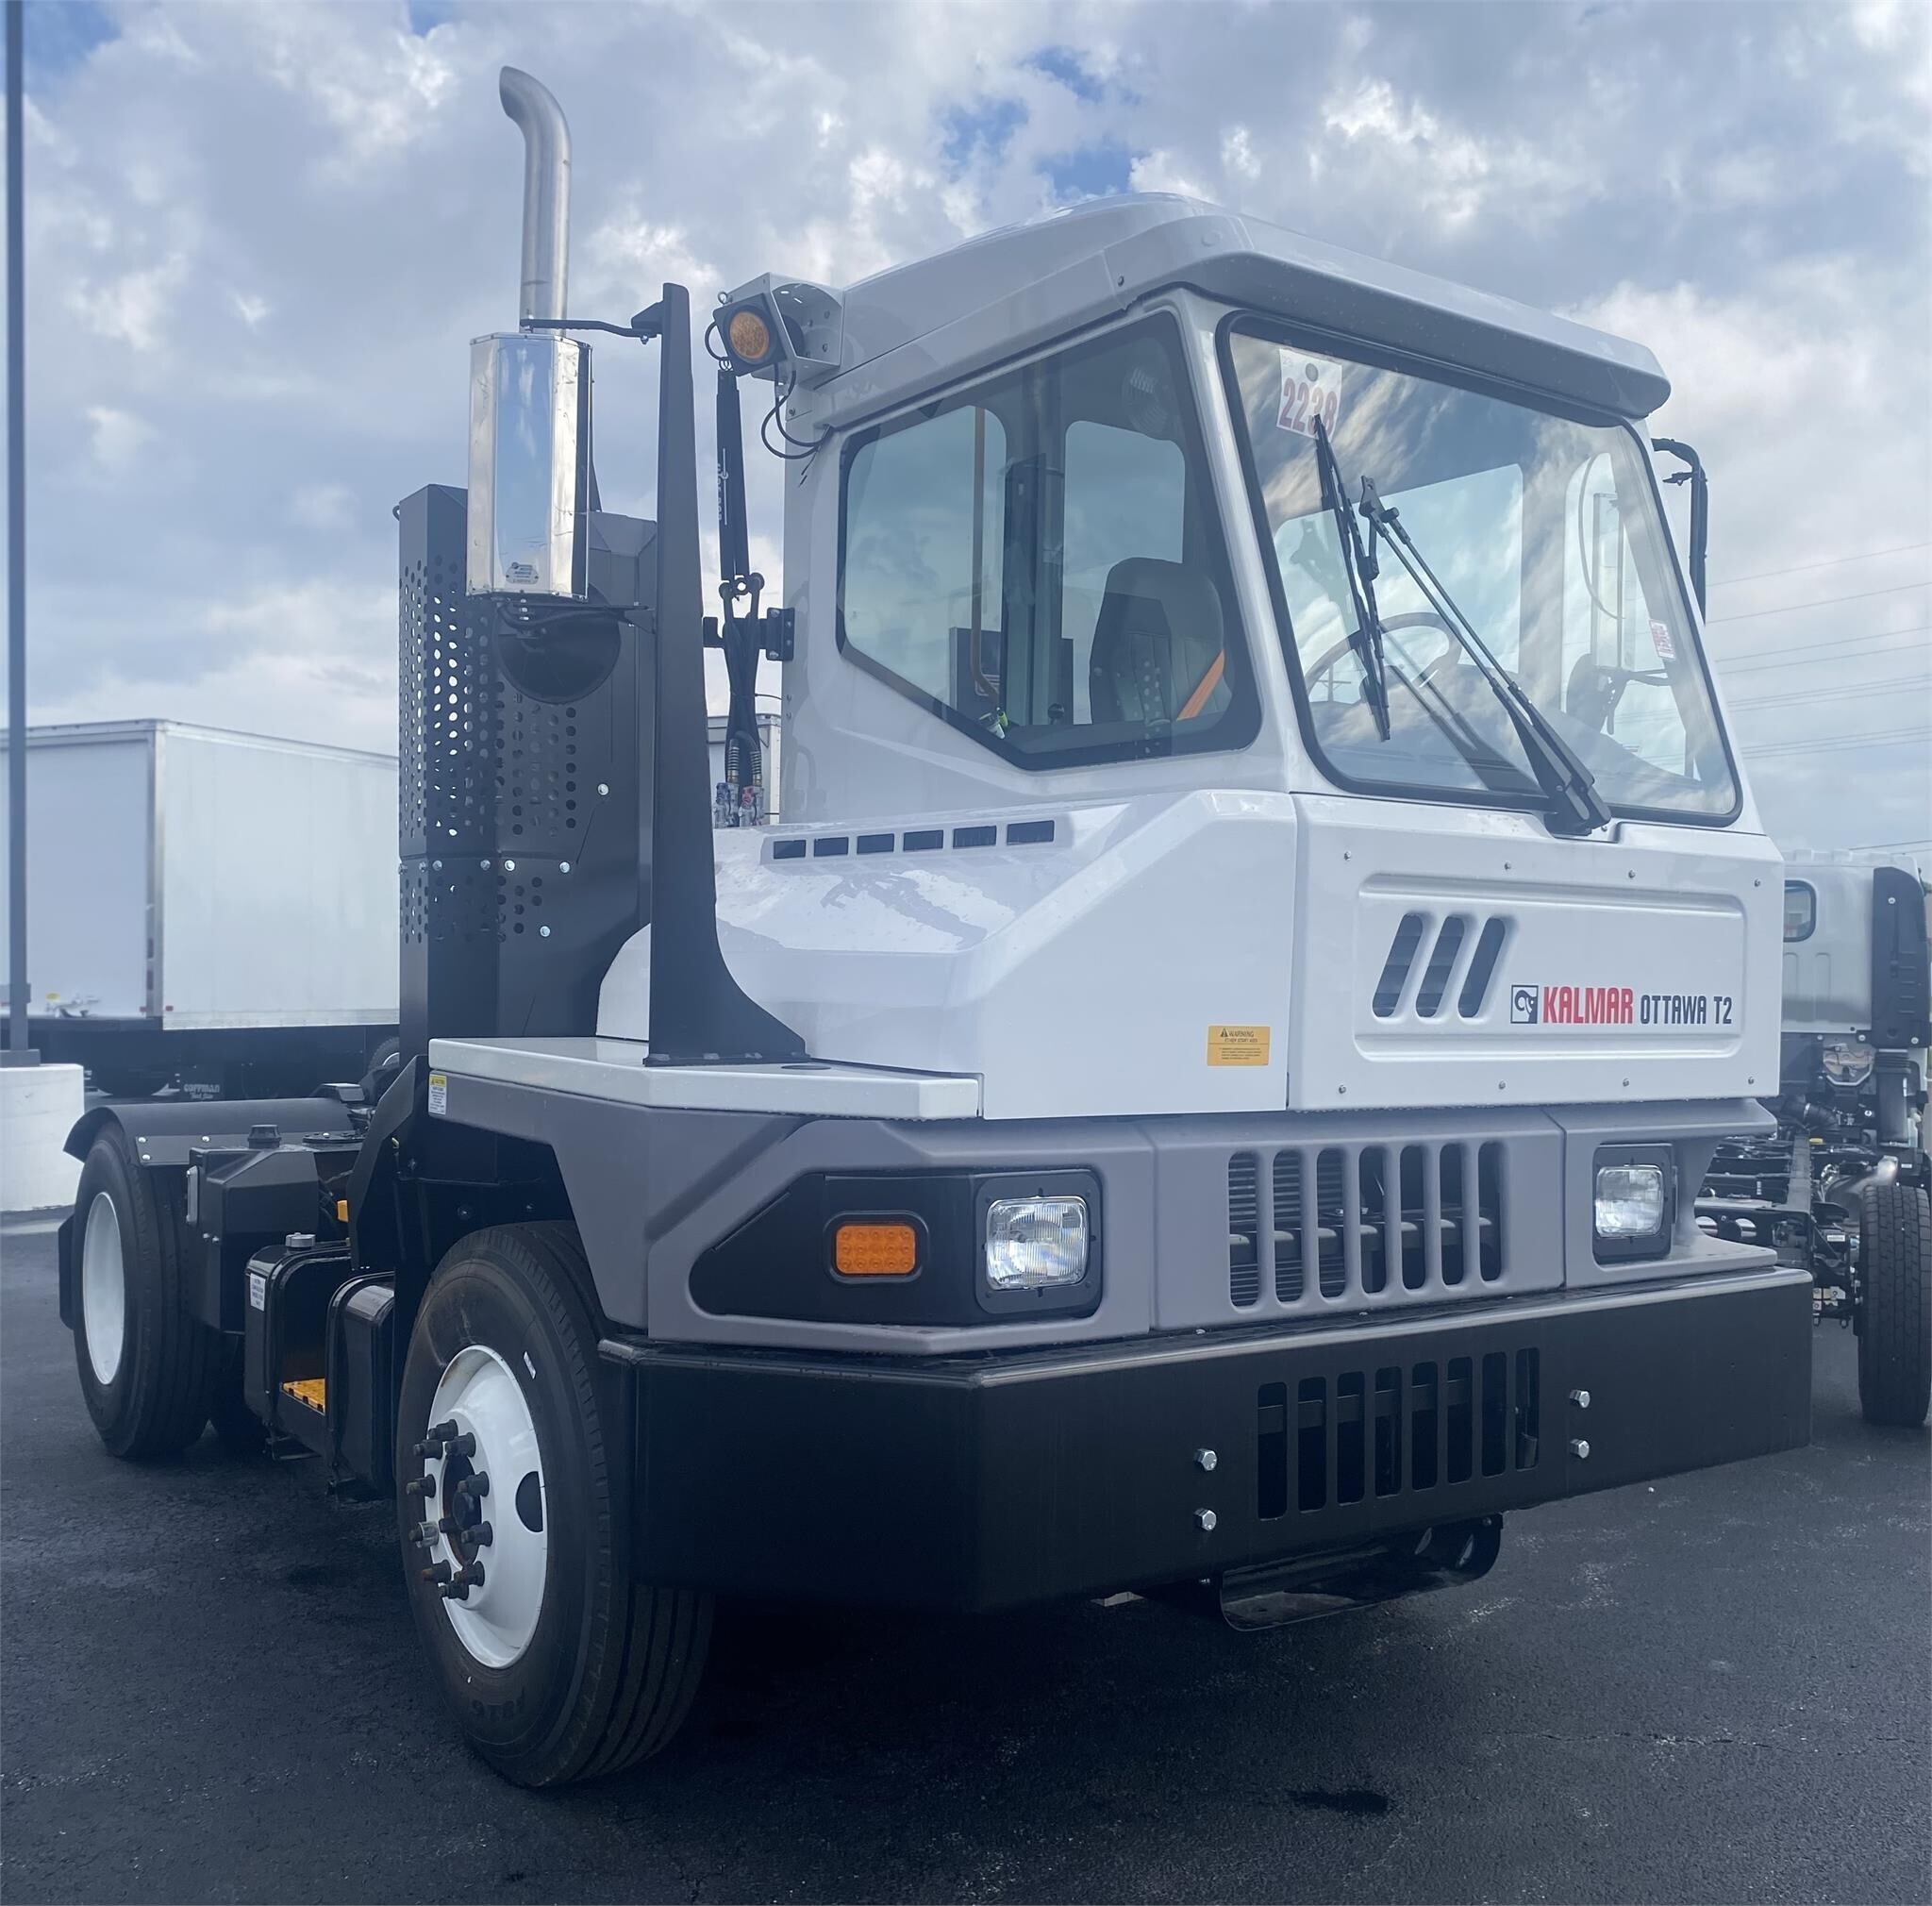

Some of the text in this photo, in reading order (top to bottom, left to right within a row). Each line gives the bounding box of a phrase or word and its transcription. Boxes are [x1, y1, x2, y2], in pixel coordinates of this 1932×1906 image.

[1543, 986, 1732, 1025] KALMAR OTTAWA T2
